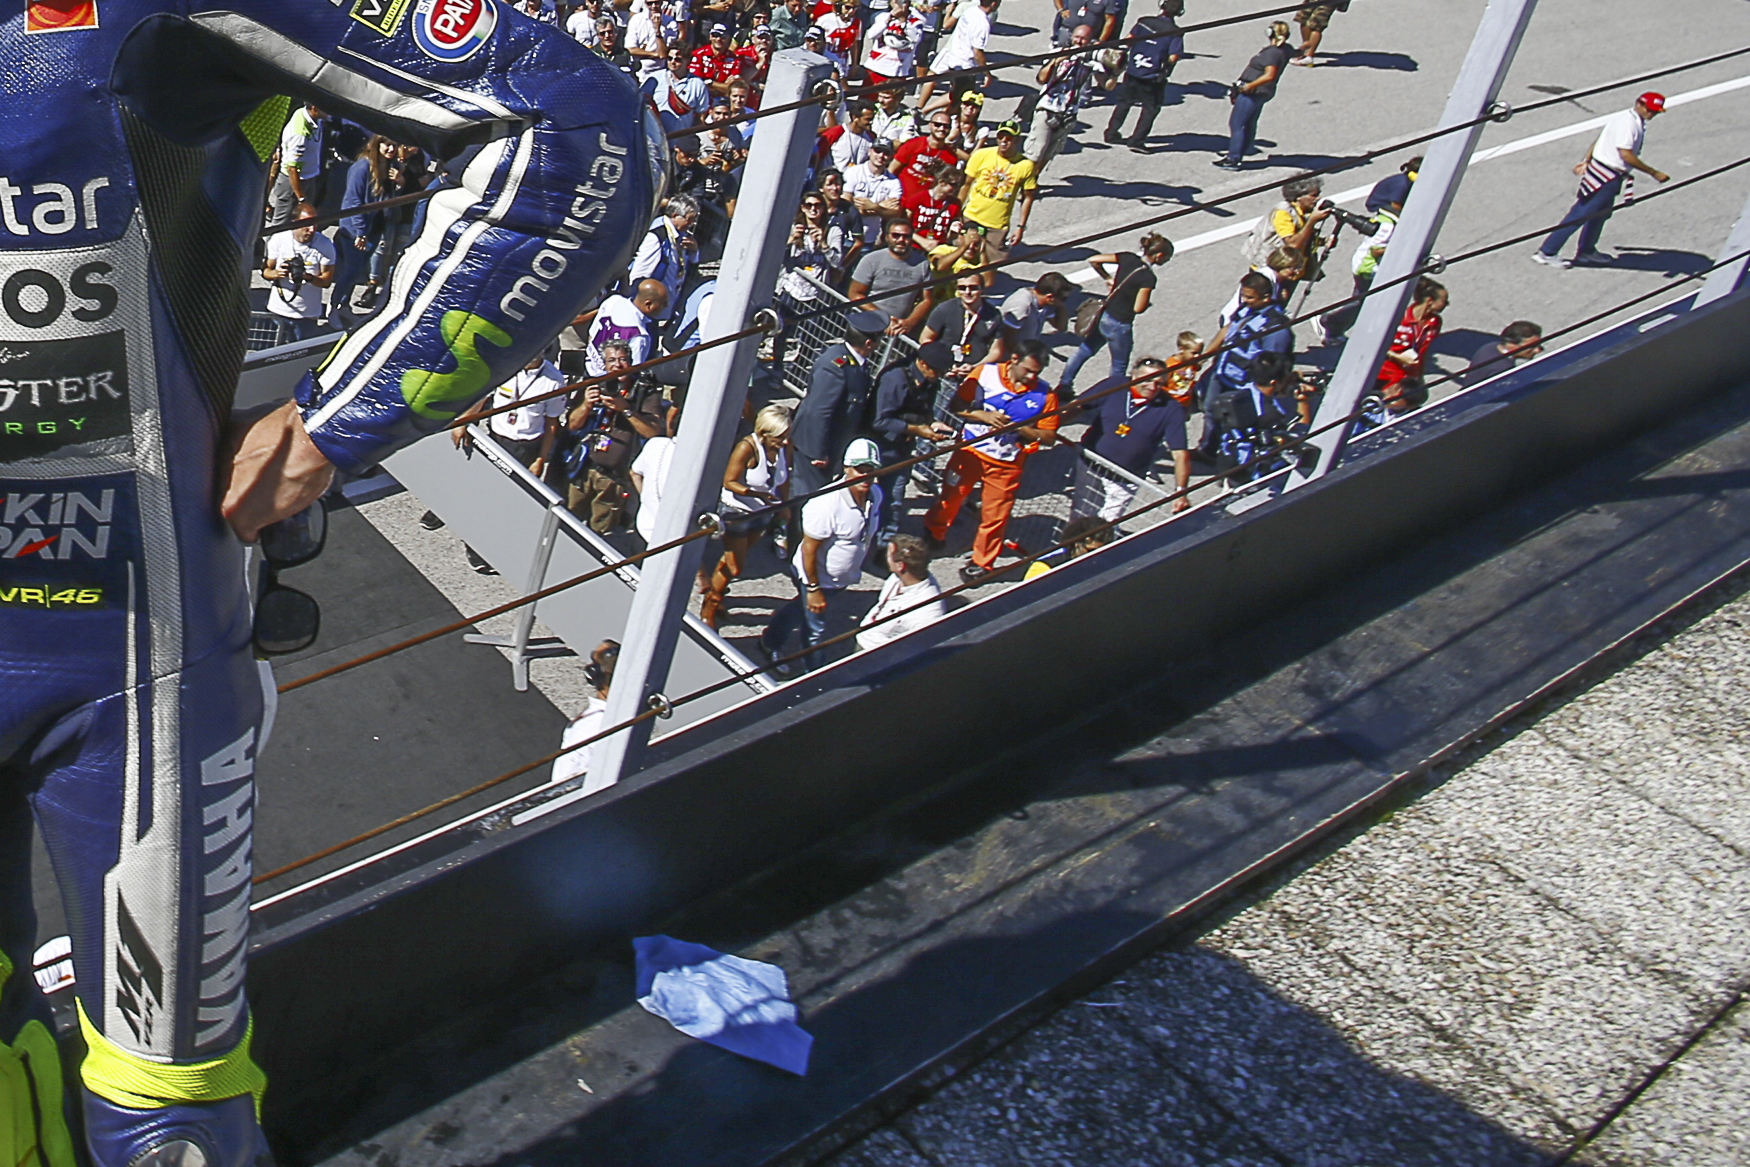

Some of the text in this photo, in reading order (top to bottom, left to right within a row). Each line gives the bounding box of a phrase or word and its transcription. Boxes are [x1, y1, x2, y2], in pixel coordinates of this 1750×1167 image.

[499, 131, 629, 322] movistar
[472, 437, 514, 475] motogp.com
[195, 727, 255, 1047] YAMAHA
